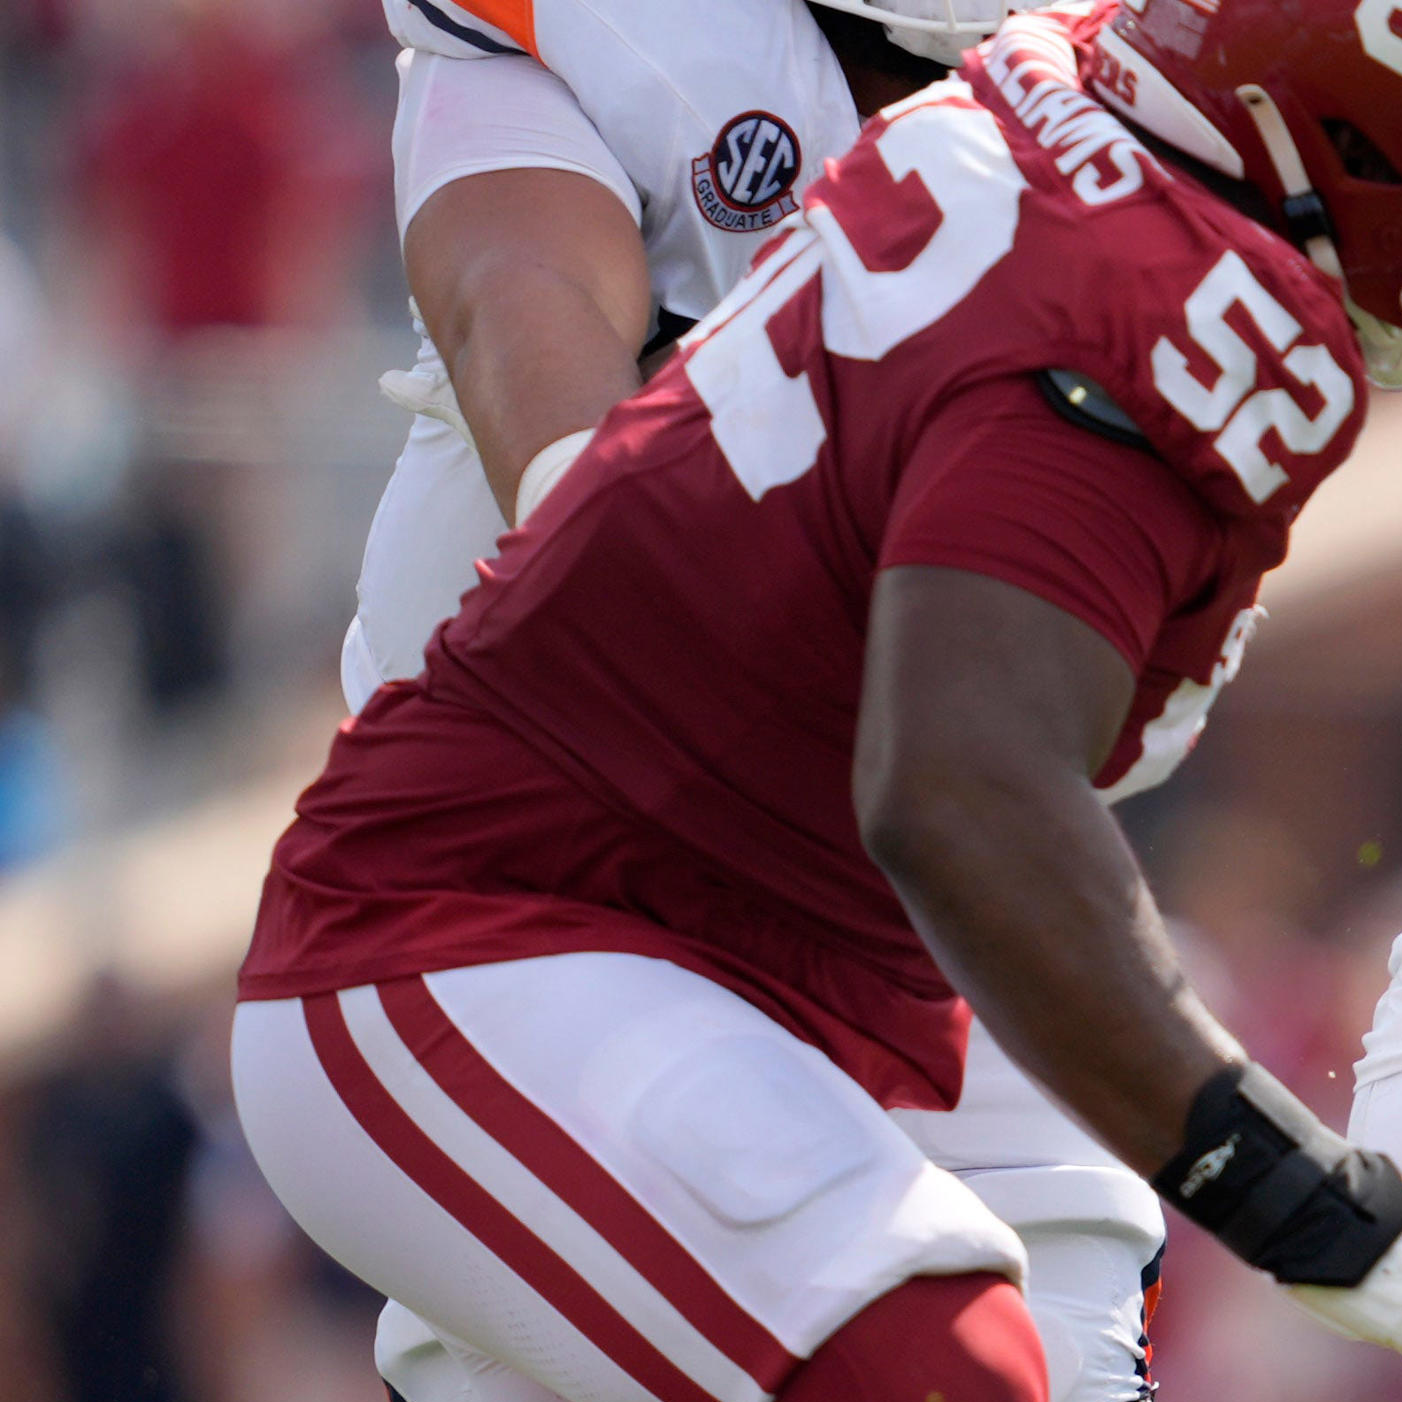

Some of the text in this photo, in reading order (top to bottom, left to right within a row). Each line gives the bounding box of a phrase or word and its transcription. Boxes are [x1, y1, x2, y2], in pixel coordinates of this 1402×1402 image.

[718, 118, 795, 204] SEC
[977, 14, 1175, 206] LLIAMS
[697, 179, 773, 229] GRADUATE
[1151, 249, 1355, 505] 52
